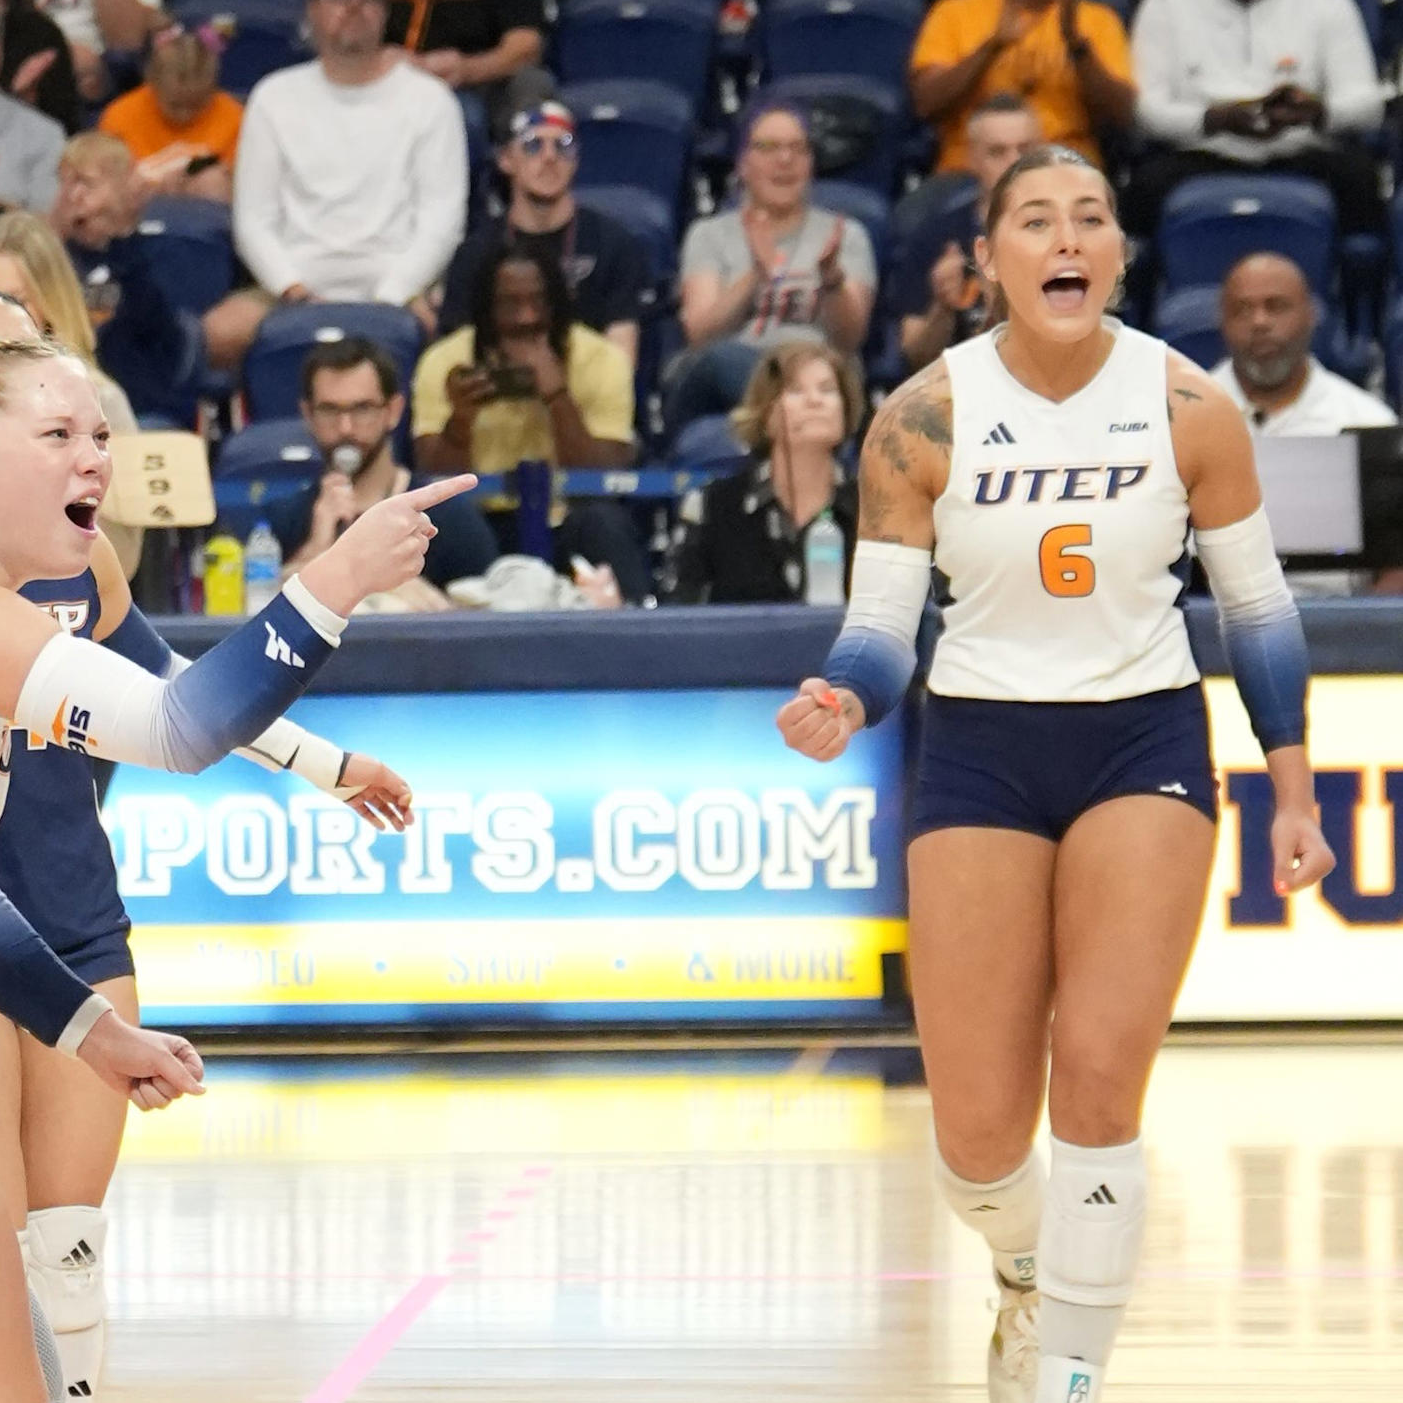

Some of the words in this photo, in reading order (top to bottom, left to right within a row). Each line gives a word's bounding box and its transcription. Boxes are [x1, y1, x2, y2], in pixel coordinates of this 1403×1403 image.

[973, 459, 1151, 506] UTEP
[1038, 524, 1096, 598] 6
[100, 786, 878, 896] PORTS.COM
